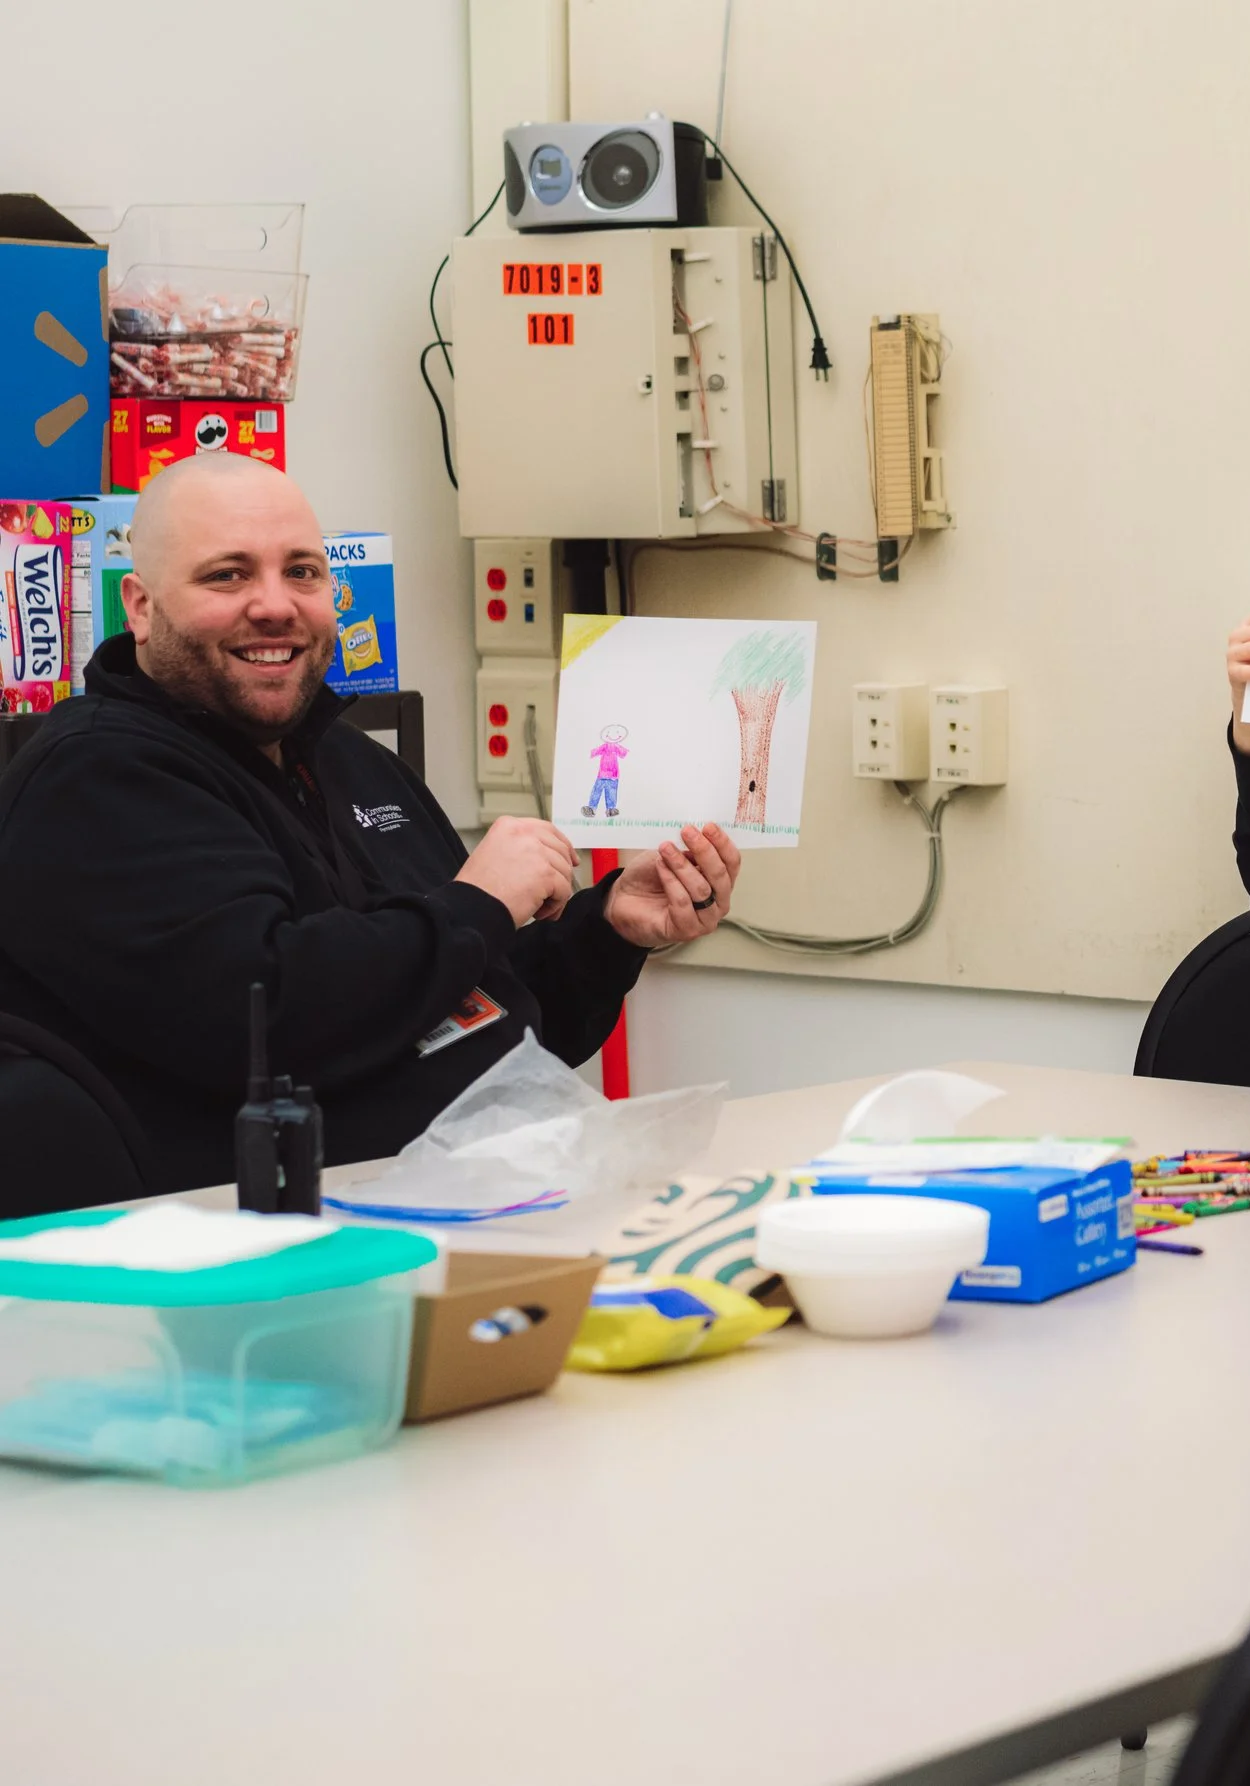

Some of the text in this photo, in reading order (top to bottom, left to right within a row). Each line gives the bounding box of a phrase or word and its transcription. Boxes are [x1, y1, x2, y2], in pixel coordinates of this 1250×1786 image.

[530, 315, 569, 344] 101
[113, 410, 129, 424] 27
[239, 420, 255, 435] 27
[60, 515, 70, 533] 22
[23, 551, 58, 677] Welch's
[365, 804, 403, 817] Communities
